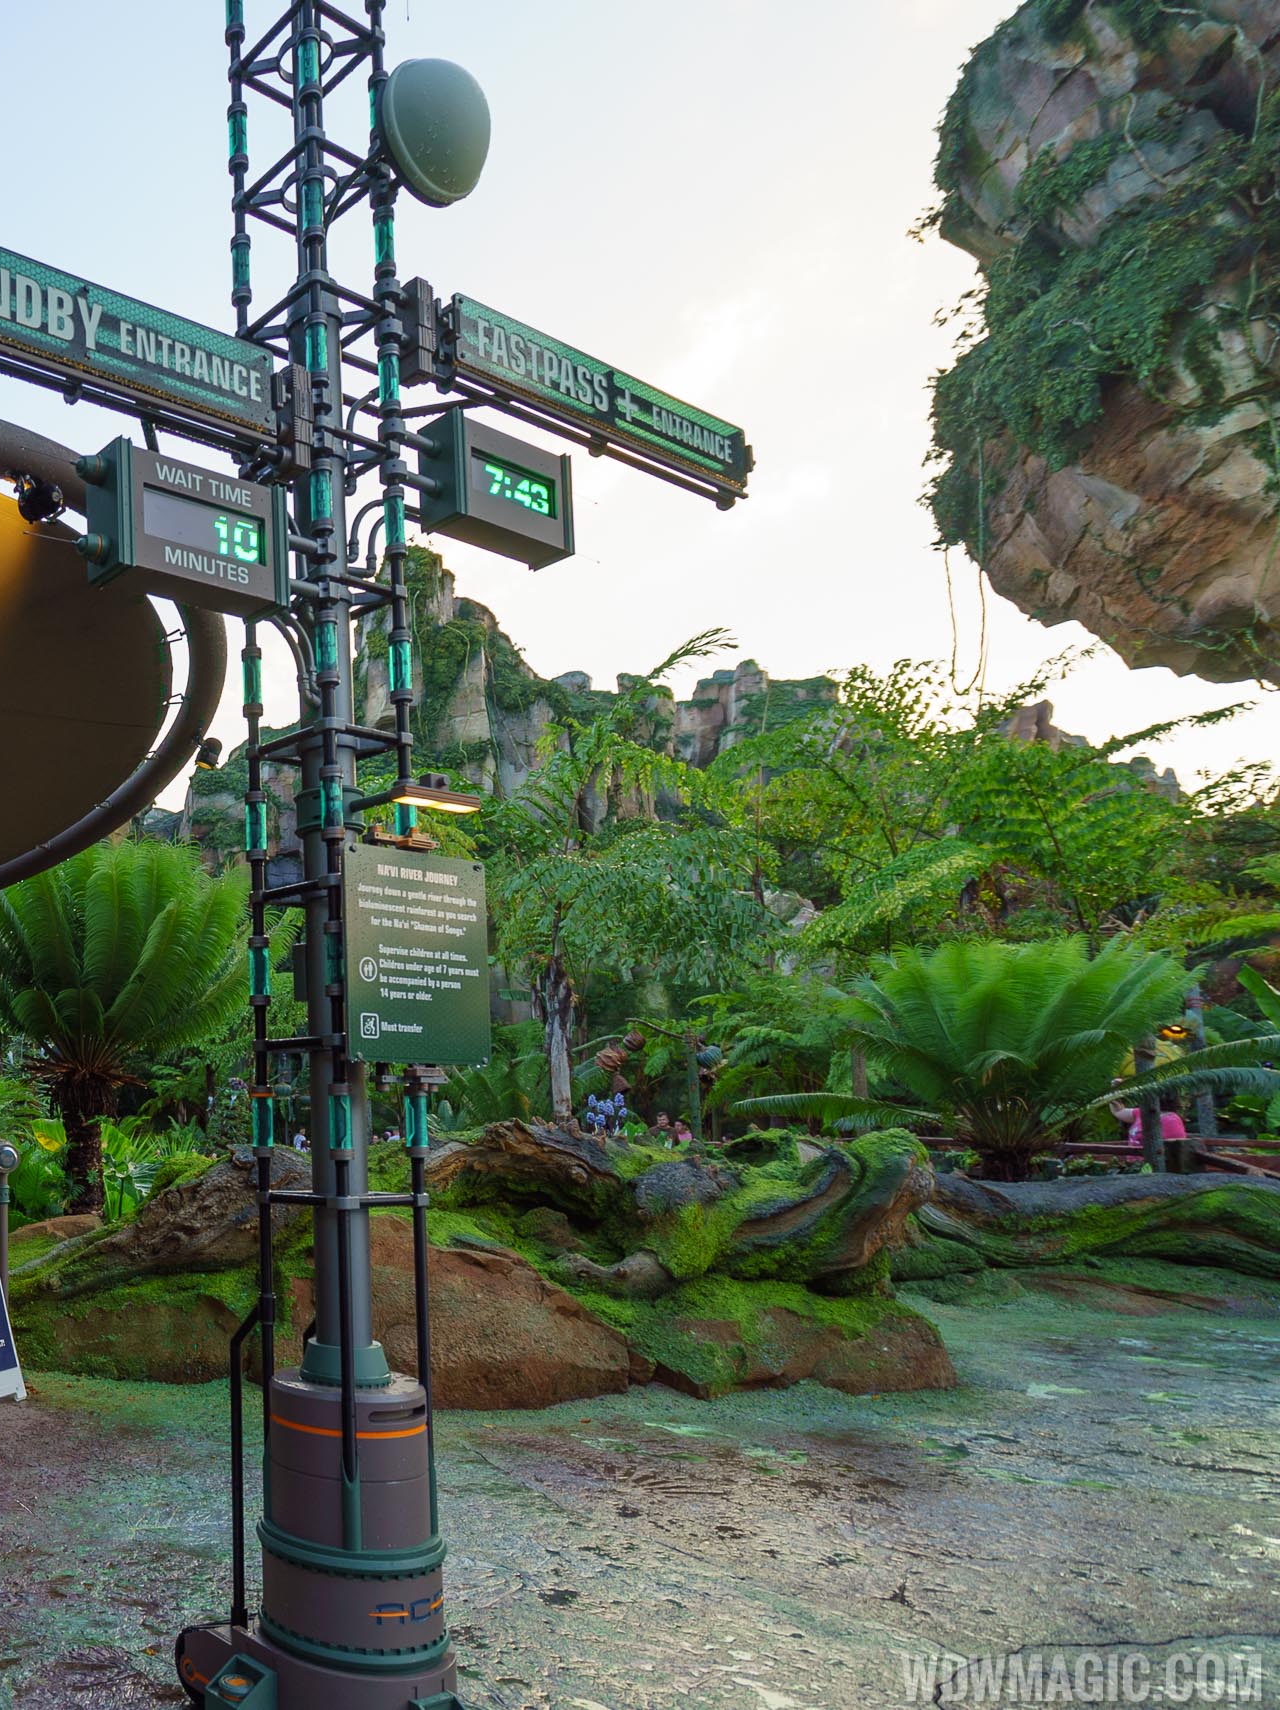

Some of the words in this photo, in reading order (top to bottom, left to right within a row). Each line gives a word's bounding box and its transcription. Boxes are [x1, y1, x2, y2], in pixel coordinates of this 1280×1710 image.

[120, 320, 262, 402] ENTRANCE
[477, 316, 609, 412] FASTPASS
[653, 406, 733, 464] ENTRANCE
[156, 462, 203, 493] WAIT
[208, 479, 251, 508] TIME
[485, 464, 549, 516] 7:43
[214, 515, 258, 562] 10
[165, 546, 249, 584] MINUTES
[400, 867, 423, 881] RIVER
[424, 871, 458, 886] JOURNEY
[358, 882, 383, 896] Journey
[384, 885, 401, 897] down
[408, 890, 426, 900] gentle
[427, 892, 442, 902] river
[443, 894, 466, 907] through
[467, 898, 477, 907] the
[358, 898, 406, 913] bioluminescent
[407, 905, 436, 917] rainforest
[438, 910, 444, 918] as
[446, 911, 456, 920] you
[457, 912, 477, 922] search
[371, 915, 380, 926] for
[382, 917, 392, 927] the
[438, 924, 444, 933] of
[378, 944, 408, 956] Supervise
[409, 947, 433, 958] children
[434, 950, 441, 959] at
[450, 952, 468, 962] times.
[379, 958, 404, 970] Children
[405, 962, 423, 972] under
[424, 964, 435, 974] age
[435, 964, 442, 974] of
[442, 964, 447, 974] 7
[448, 966, 464, 976] years
[465, 967, 479, 977] must
[379, 973, 387, 983] be
[388, 975, 427, 987] accompanied
[428, 977, 435, 989] by
[441, 980, 461, 990] person
[380, 988, 389, 998] 14
[389, 990, 406, 1000] years
[407, 991, 415, 1000] or
[415, 991, 433, 1001] older.
[381, 1021, 398, 1032] Must
[398, 1023, 423, 1034] transfer
